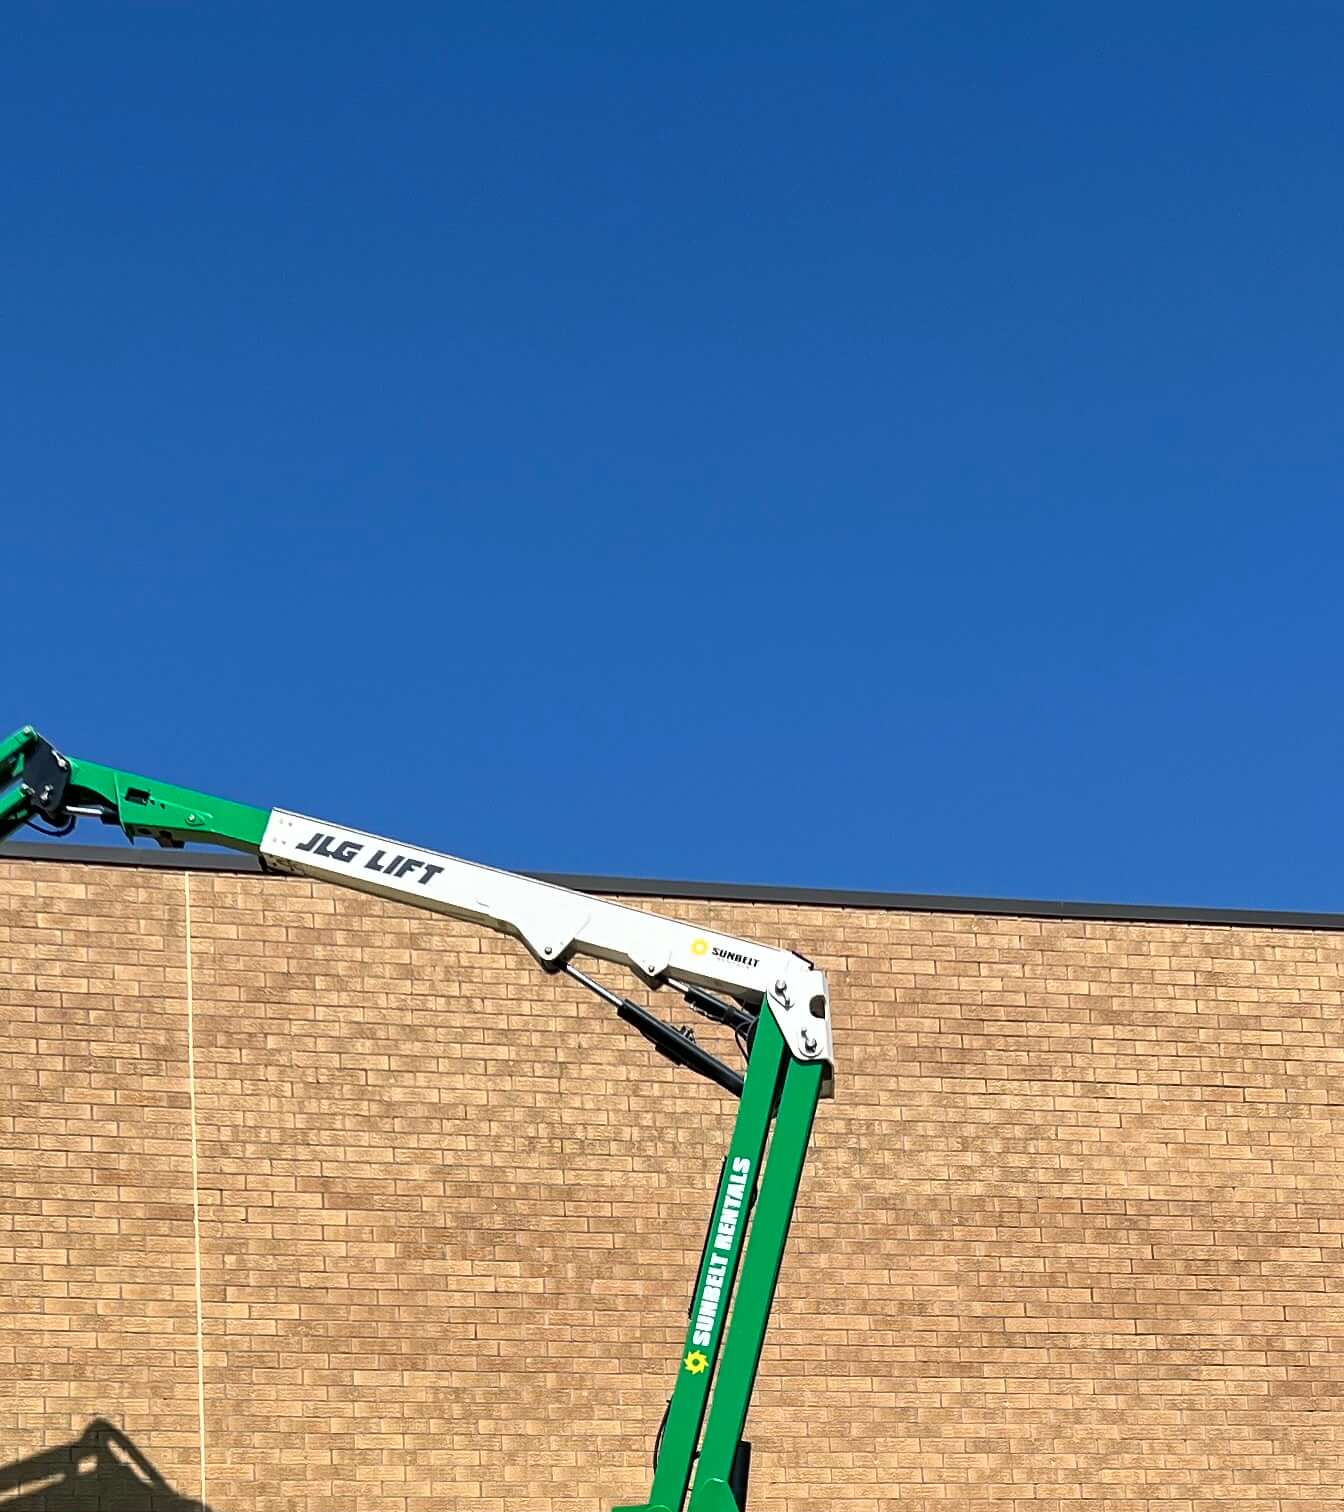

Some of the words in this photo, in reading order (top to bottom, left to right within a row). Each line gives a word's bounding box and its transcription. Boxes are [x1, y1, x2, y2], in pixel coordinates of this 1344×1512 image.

[296, 832, 361, 864] JLG
[364, 850, 444, 884] LIFT
[711, 947, 760, 967] SUNBELT
[693, 1252, 729, 1347] SUNBELT
[713, 1156, 751, 1250] RENTALS
